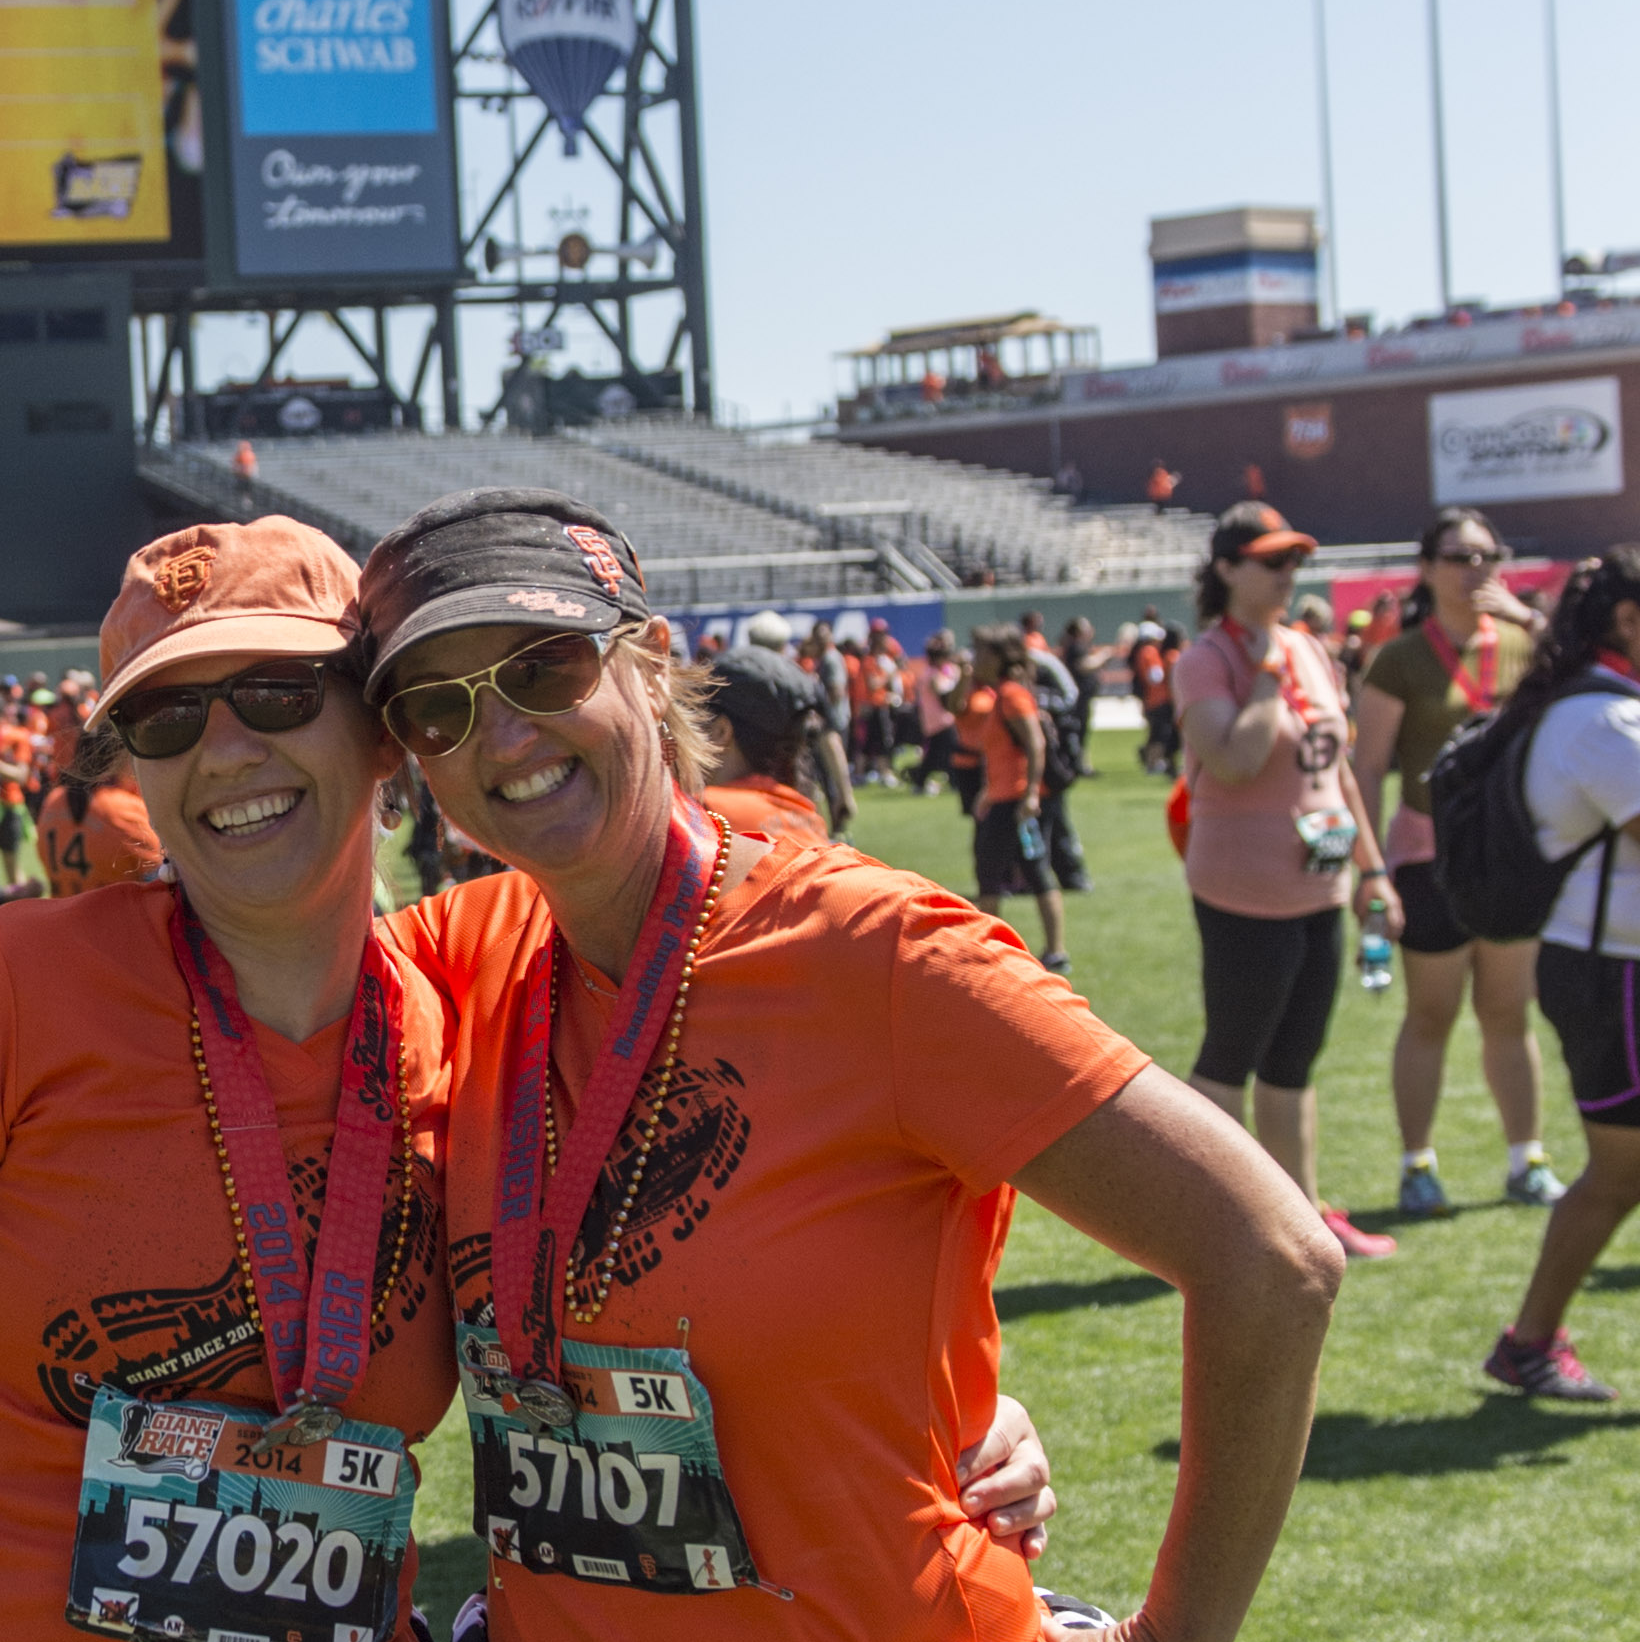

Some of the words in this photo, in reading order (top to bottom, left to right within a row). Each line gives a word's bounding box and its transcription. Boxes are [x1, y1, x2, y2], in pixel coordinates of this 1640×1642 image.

[255, 35, 417, 74] SCHWAB
[45, 830, 92, 877] 14
[612, 930, 681, 1061] Benefiting
[663, 837, 704, 928] Projec
[247, 1201, 303, 1306] 2014
[126, 1360, 179, 1386] GIANT
[180, 1336, 227, 1366] RACE
[271, 1319, 307, 1376] 5K
[311, 1269, 366, 1407] NISHER
[628, 1376, 677, 1413] 5K
[137, 1432, 213, 1460] RACE
[151, 1412, 220, 1437] GIANT
[233, 1442, 303, 1476] 2014
[338, 1447, 385, 1490] 5K
[507, 1429, 681, 1527] 57107
[116, 1497, 365, 1608] 57020
